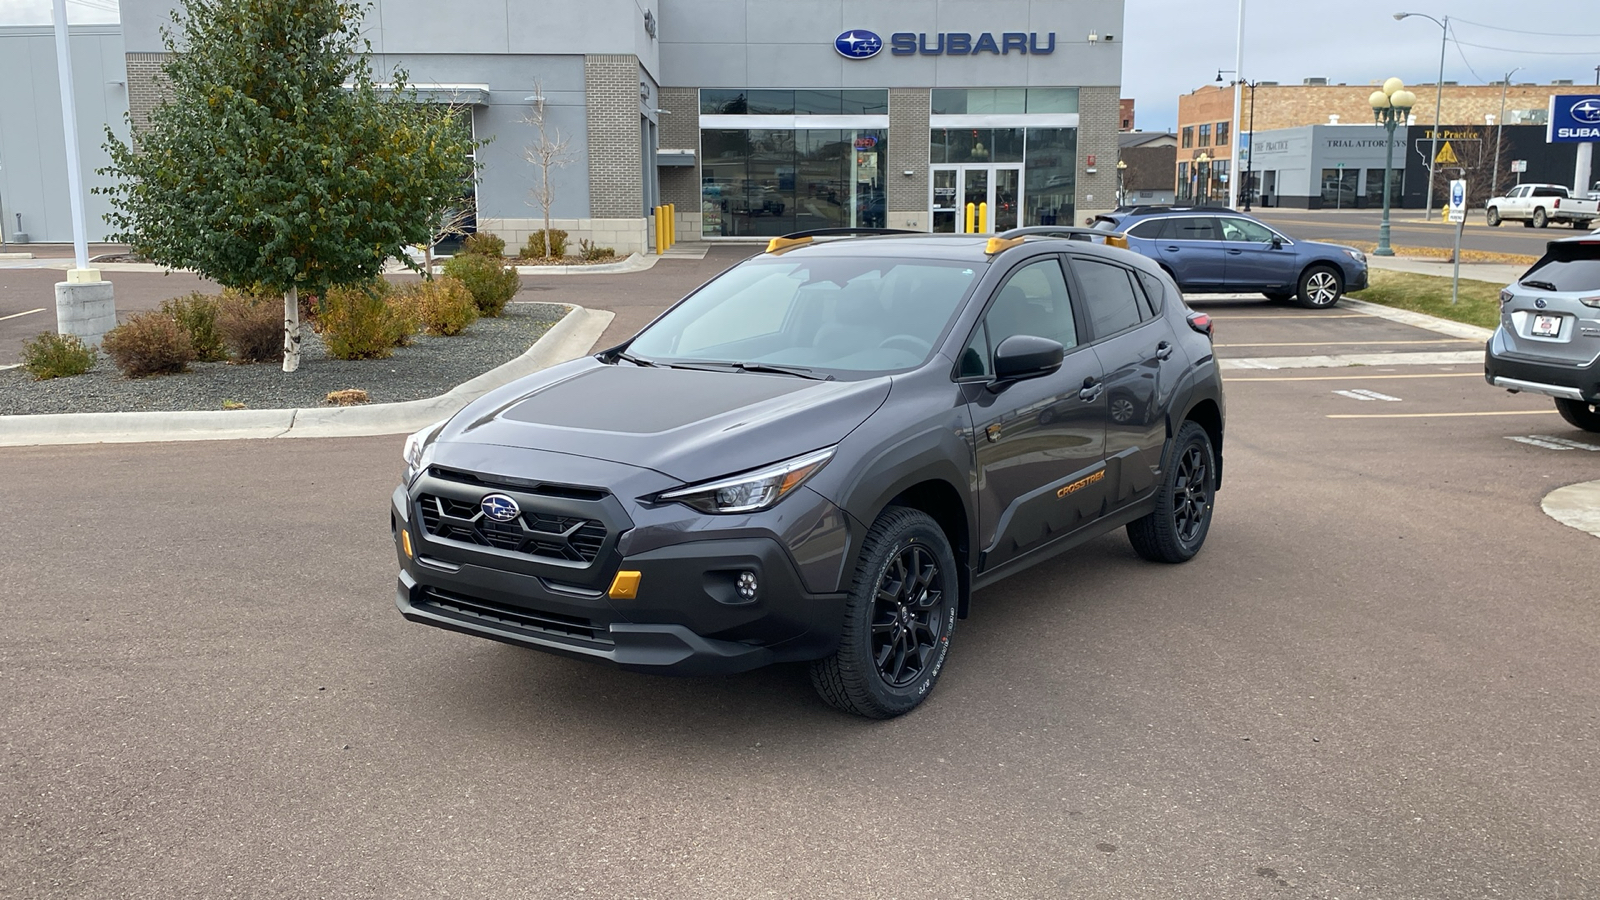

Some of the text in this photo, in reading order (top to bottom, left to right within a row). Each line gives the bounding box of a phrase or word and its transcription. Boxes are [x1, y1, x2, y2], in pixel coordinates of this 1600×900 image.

[891, 32, 1056, 56] SUBARU
[1444, 130, 1478, 139] Practce
[854, 138, 875, 148] OPEN
[1327, 140, 1354, 148] TRIAL
[1057, 469, 1106, 499] CROSSTREK
